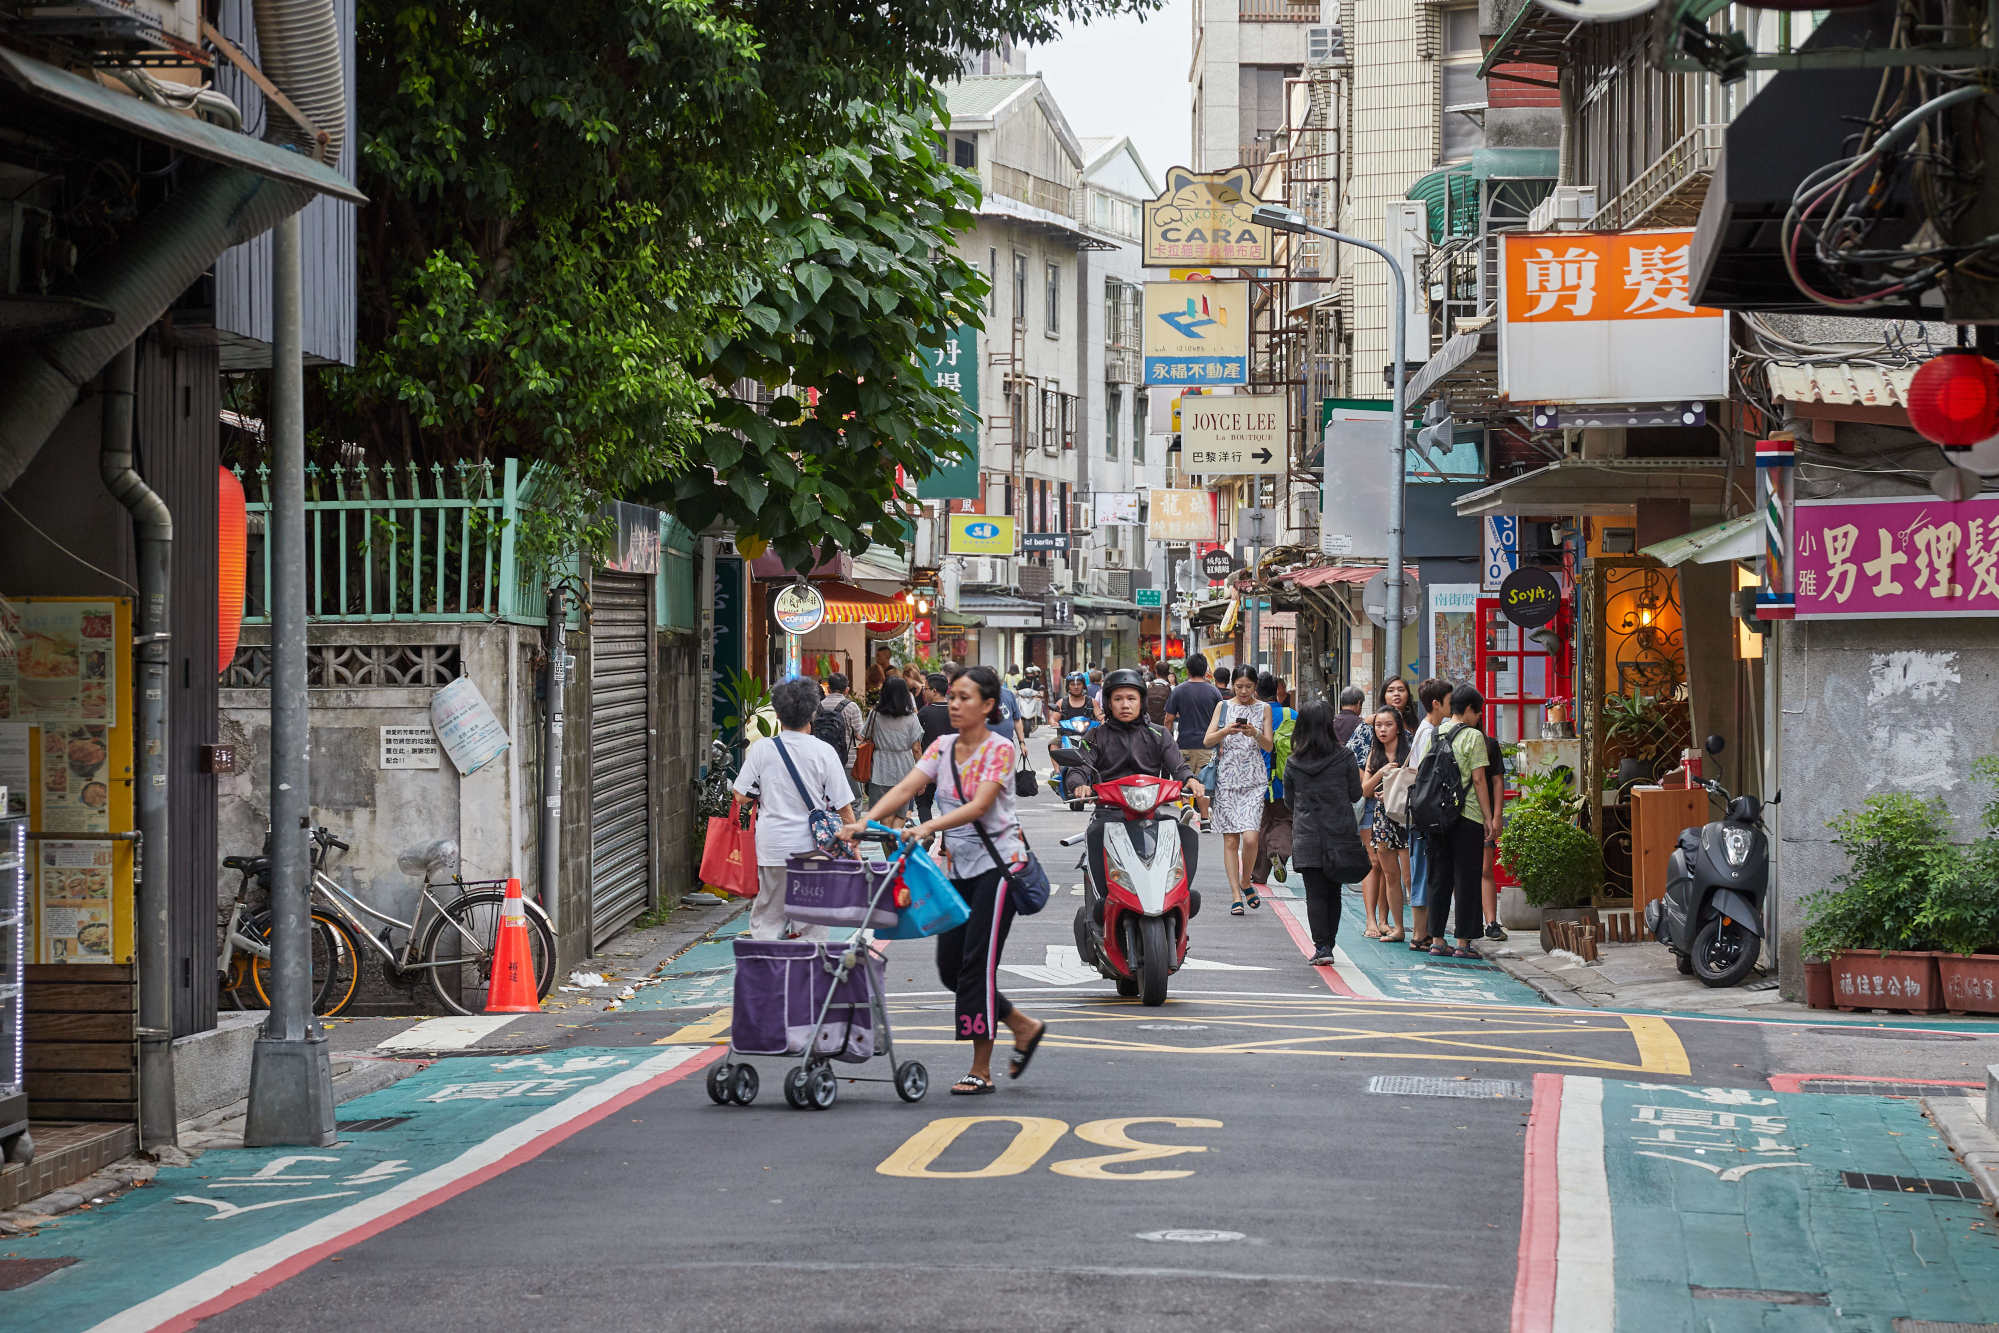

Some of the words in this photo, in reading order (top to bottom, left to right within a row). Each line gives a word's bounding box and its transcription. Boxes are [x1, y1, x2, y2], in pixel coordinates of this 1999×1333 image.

[1160, 227, 1259, 244] CARA
[1522, 243, 1696, 318] 剪髮
[1151, 362, 1242, 380] 永福不動產
[1191, 412, 1242, 432] JOYCE
[1246, 412, 1277, 431] LEE
[1230, 434, 1274, 442] BOUTIQUE
[1191, 451, 1243, 464] 巴黎洋行
[1798, 530, 1818, 597] 小雅
[1818, 515, 1999, 605] 男士理髮
[1839, 972, 1921, 998] 福住里公物
[959, 1013, 986, 1036] 36
[875, 1115, 1224, 1181] 30
